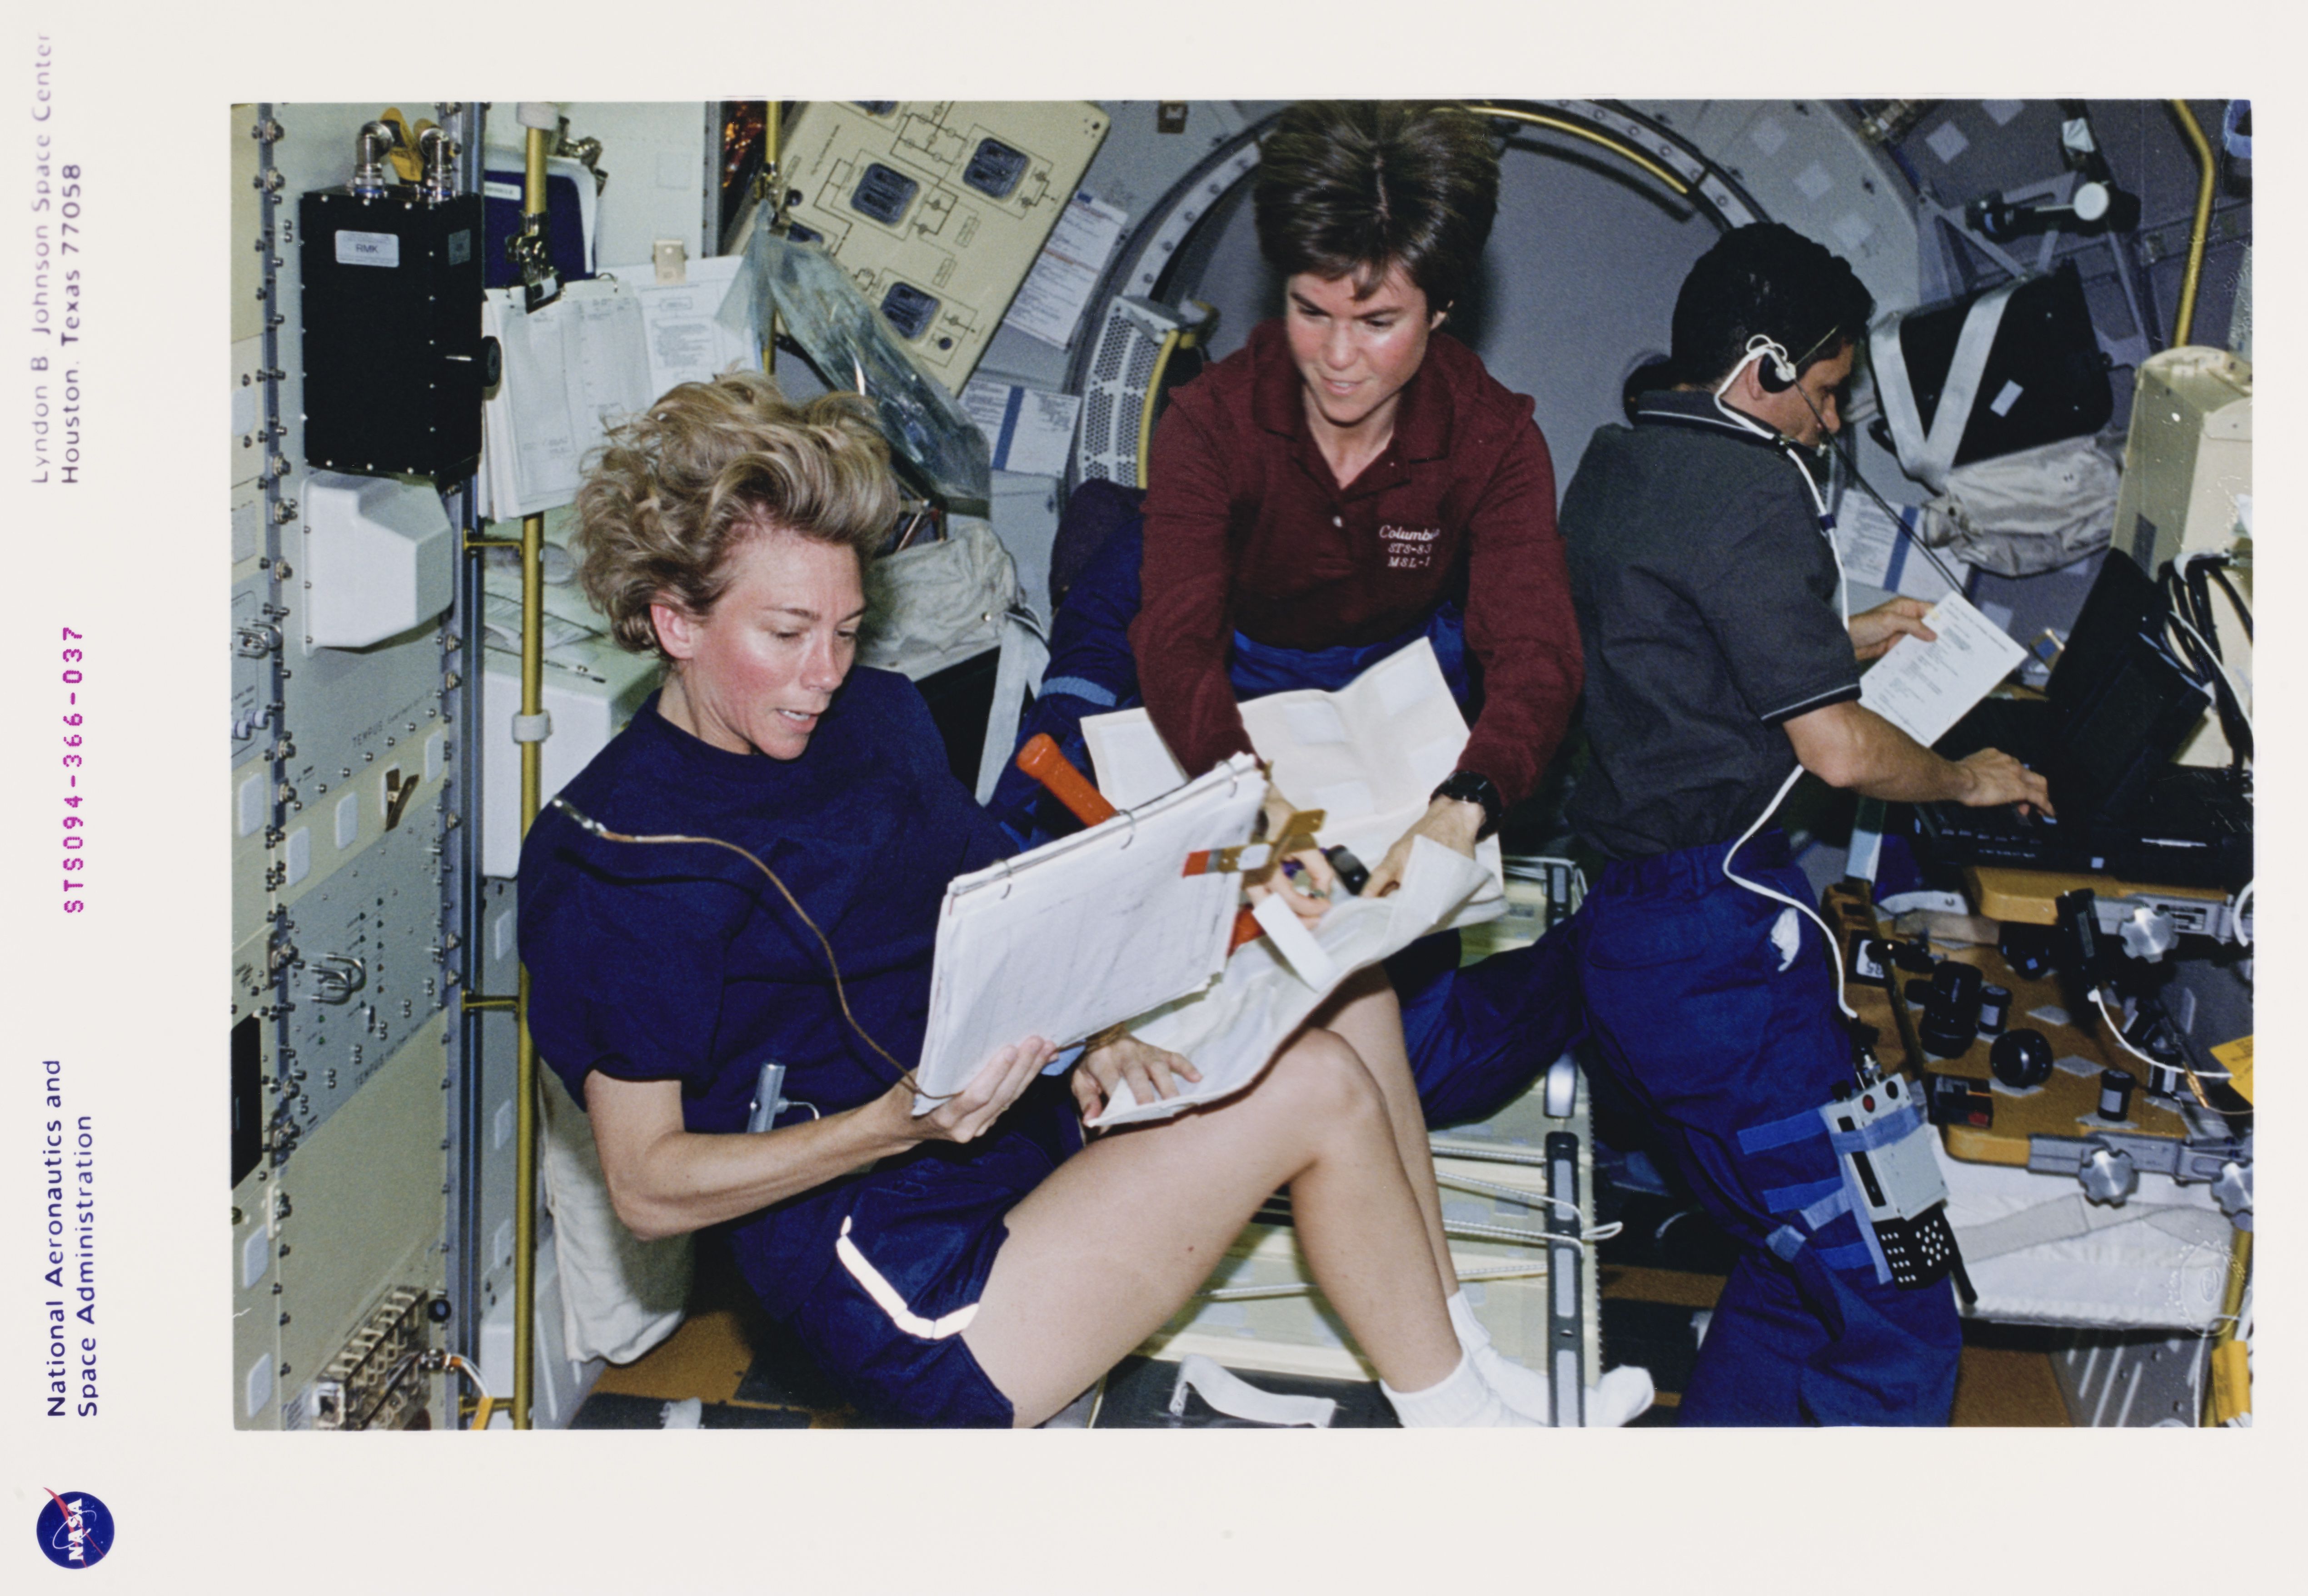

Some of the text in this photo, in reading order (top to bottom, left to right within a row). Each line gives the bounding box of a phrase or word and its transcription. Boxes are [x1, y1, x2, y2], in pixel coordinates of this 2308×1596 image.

[356, 244, 378, 253] RMK
[1388, 543, 1432, 554] STS-83
[1388, 556, 1431, 568] MSL-1
